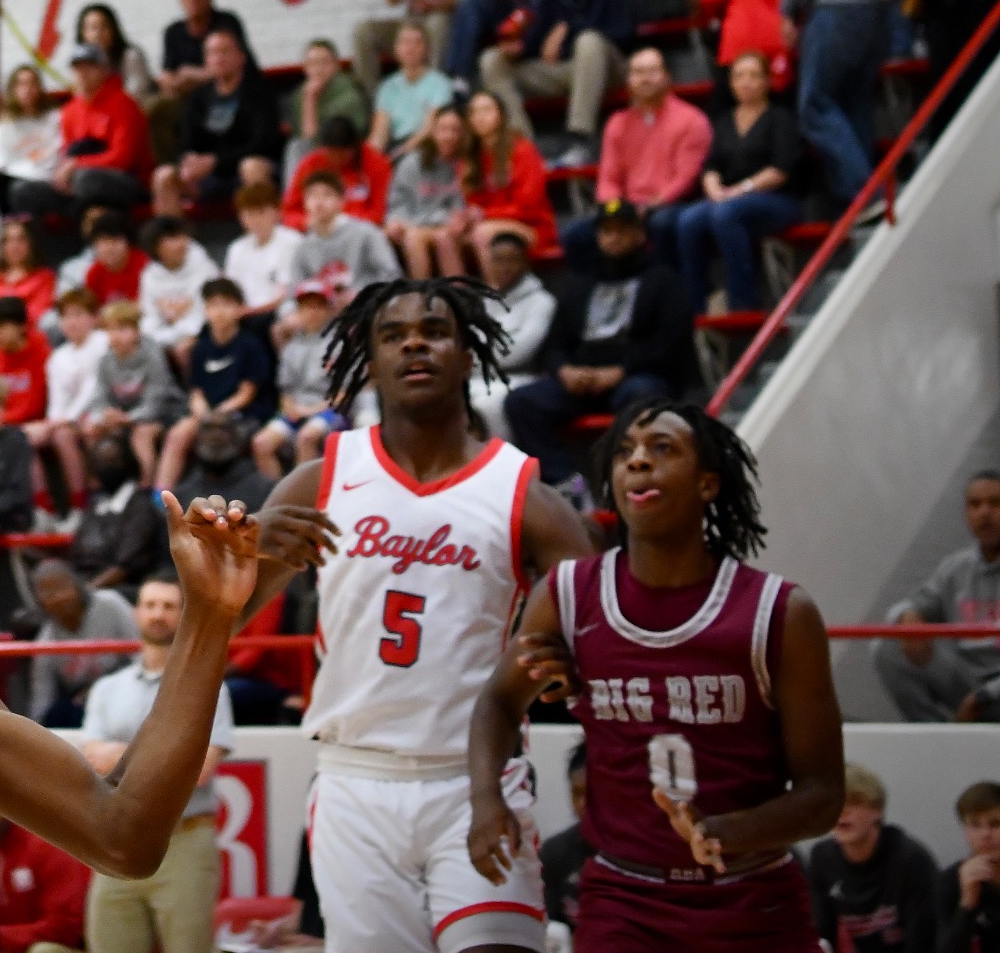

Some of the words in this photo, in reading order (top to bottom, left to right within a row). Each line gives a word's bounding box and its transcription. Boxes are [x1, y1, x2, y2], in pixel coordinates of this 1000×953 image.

[347, 514, 480, 574] Baylor
[378, 590, 426, 668] 5
[587, 677, 654, 723] BIG
[665, 675, 746, 725] RED
[648, 733, 698, 804] 0
